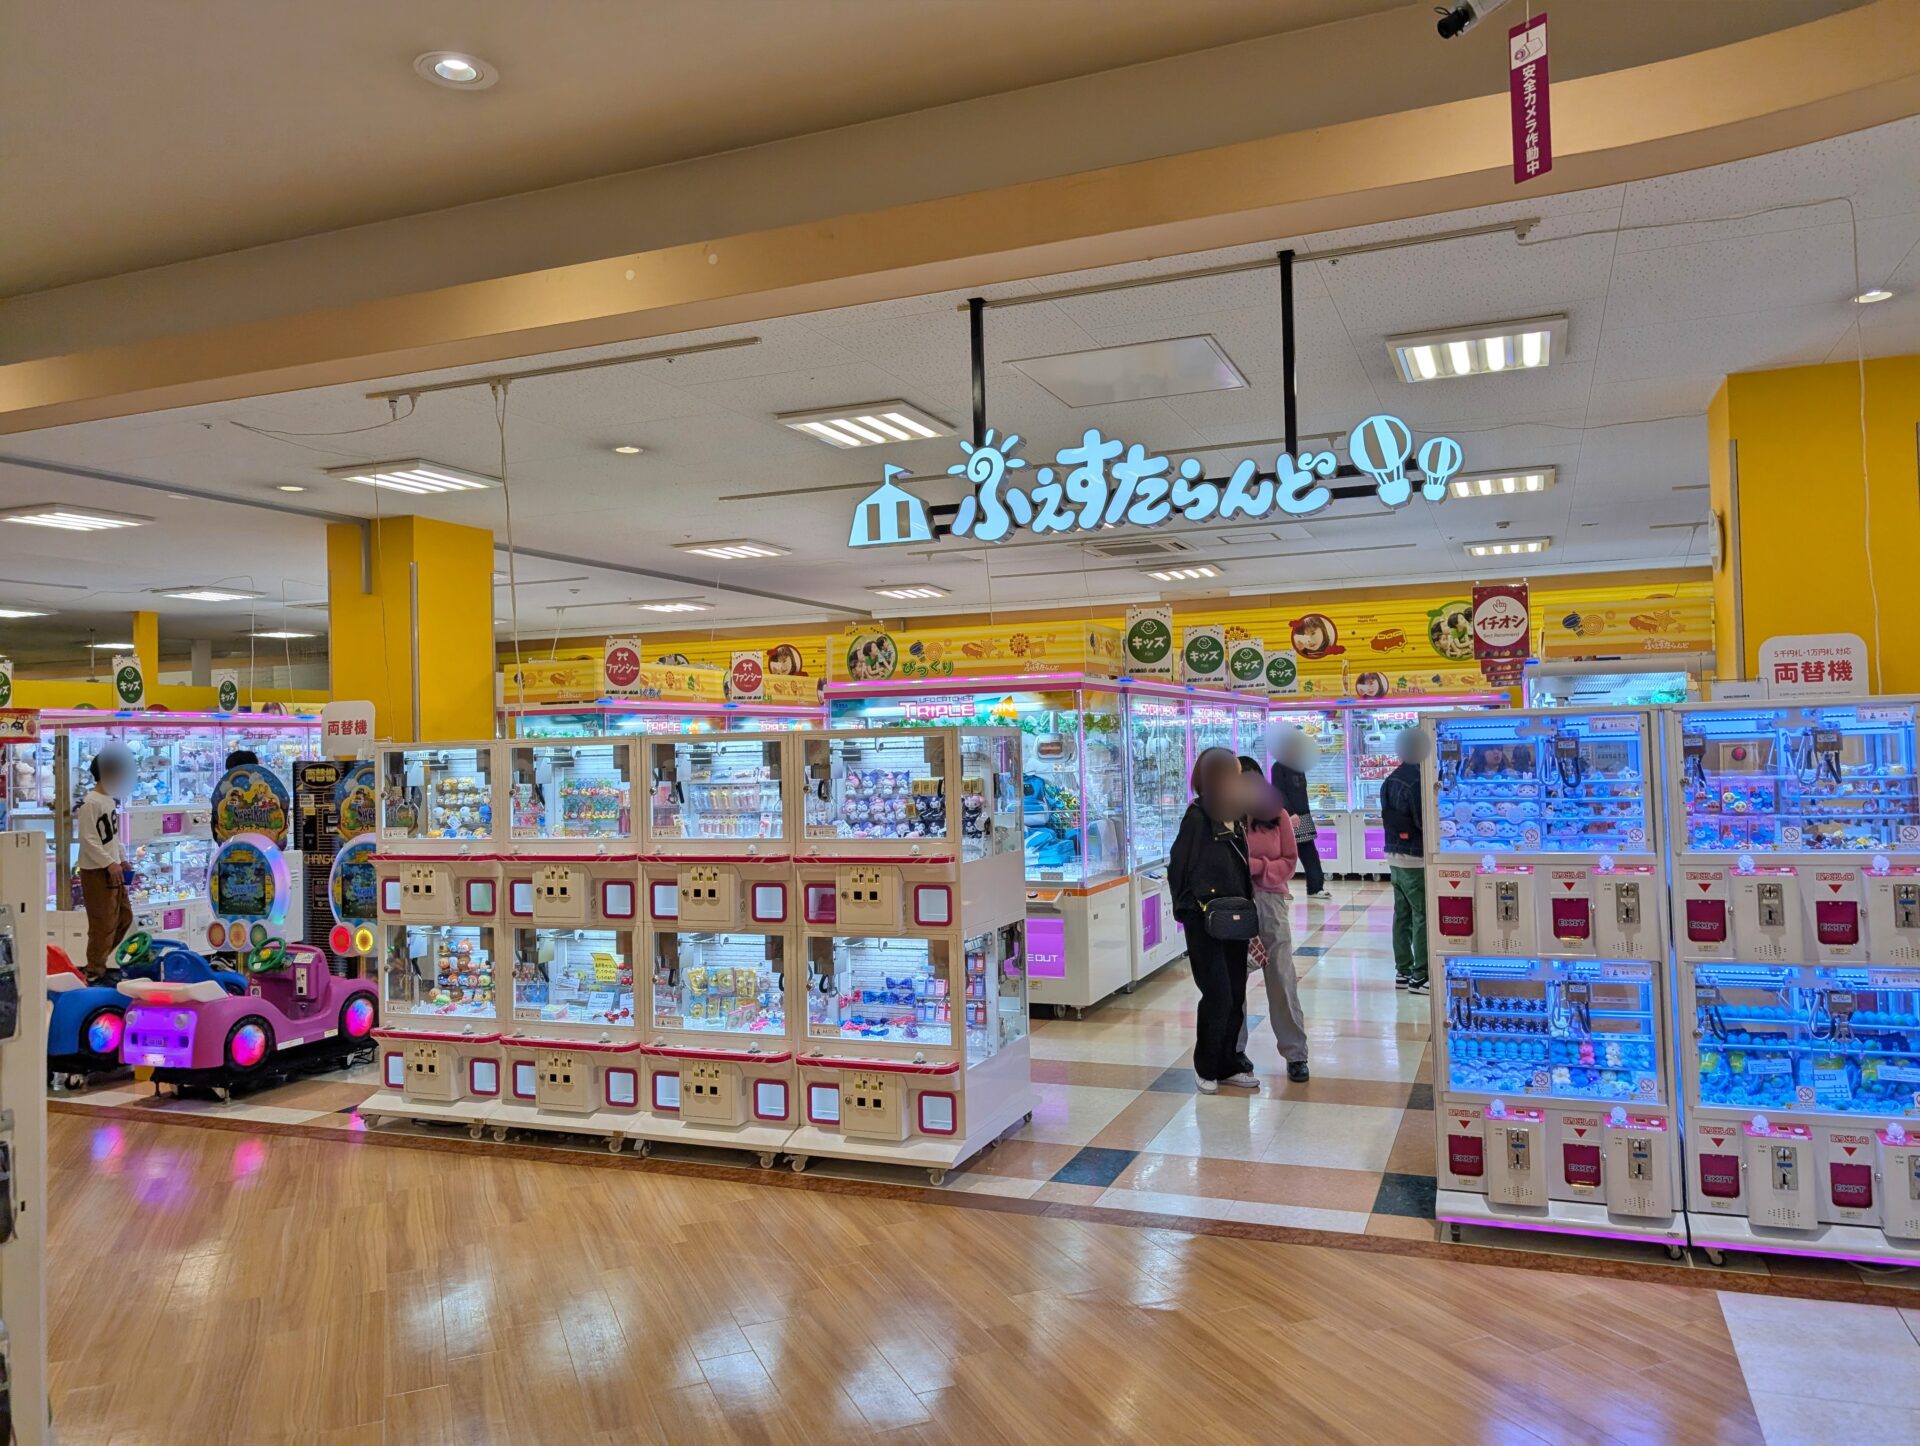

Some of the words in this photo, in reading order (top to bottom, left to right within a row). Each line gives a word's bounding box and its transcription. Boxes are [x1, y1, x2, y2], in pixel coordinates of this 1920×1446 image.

[1522, 63, 1540, 175] 安全カメラ作動中
[948, 428, 1338, 543] ふぇすたらんど
[1477, 614, 1525, 630] イチオシ
[1132, 635, 1167, 649] キッズ
[1189, 649, 1220, 662] キッズ
[1836, 647, 1852, 656] 対応
[605, 662, 640, 675] ファンシー
[902, 659, 954, 677] びっくり
[1234, 658, 1261, 671] キッズ
[733, 671, 763, 683] ファンシー
[1269, 668, 1294, 679] キッズ
[1774, 660, 1853, 684] 両替機
[119, 680, 141, 692] キッズ
[220, 690, 236, 701] キッズ
[898, 700, 975, 719] TRIPLE
[328, 719, 368, 736] 両替機
[643, 718, 680, 733] TRIPLE
[305, 768, 337, 782] 両替機
[1035, 954, 1059, 963] OUT
